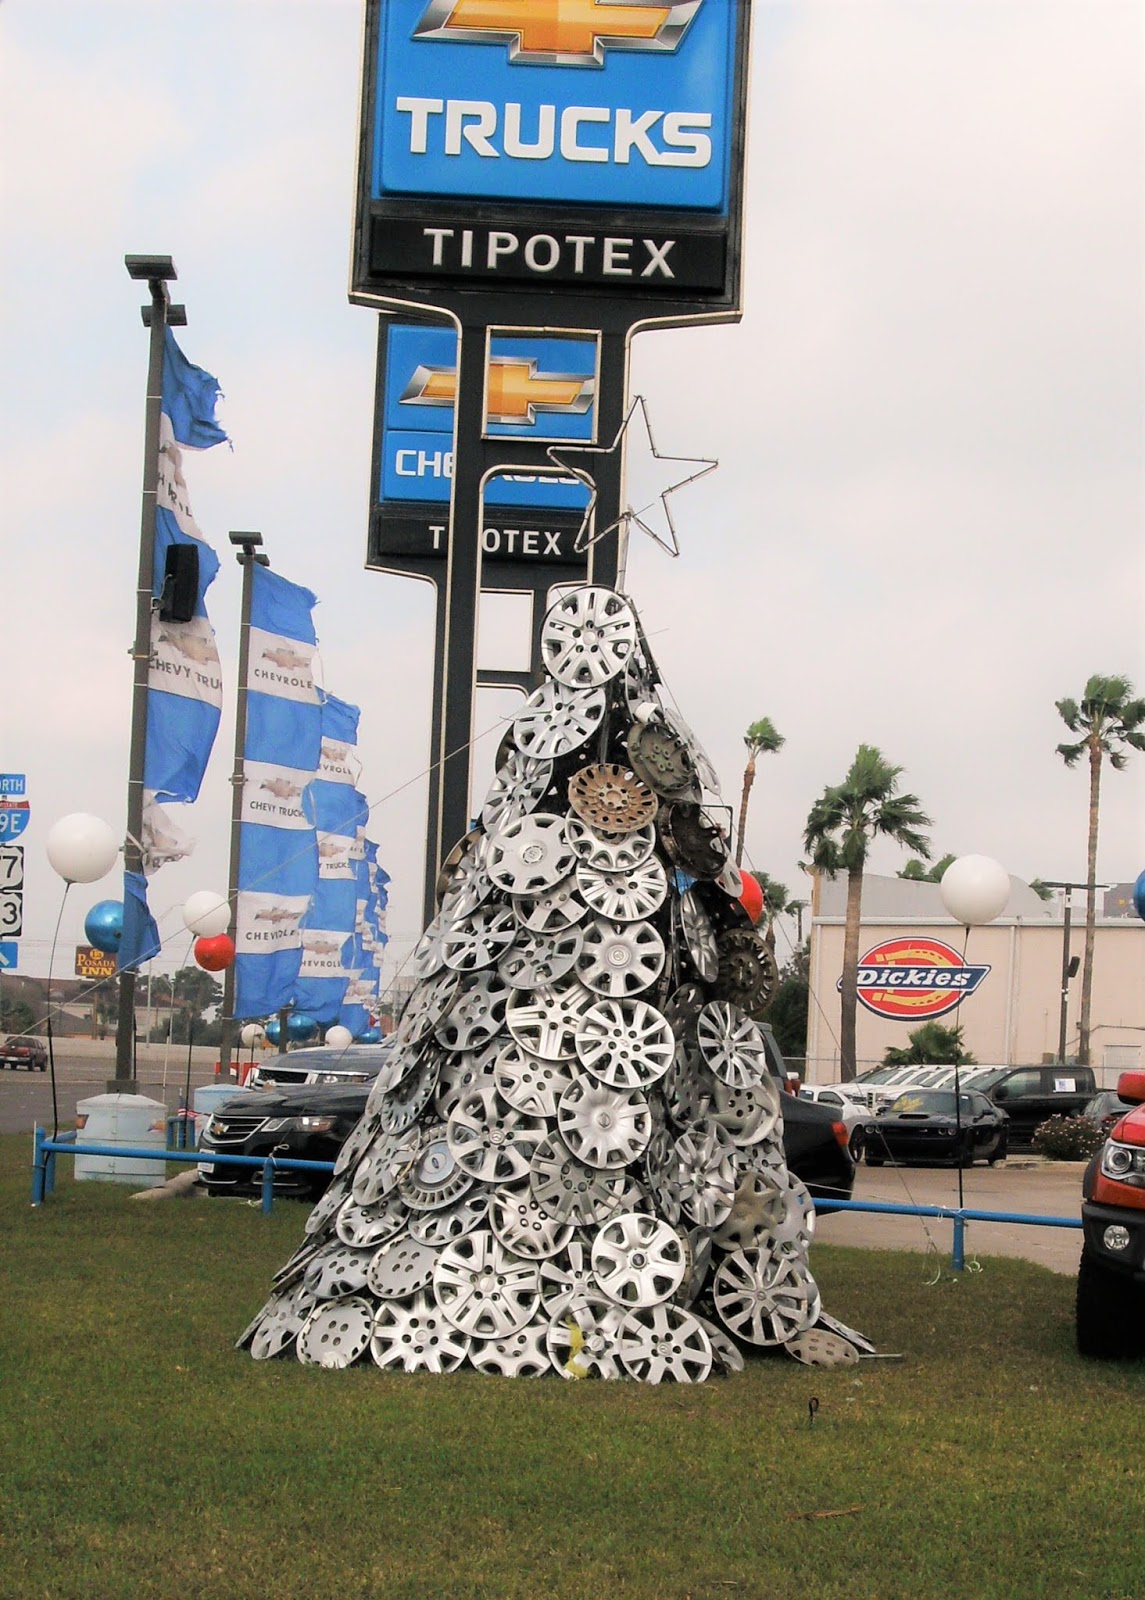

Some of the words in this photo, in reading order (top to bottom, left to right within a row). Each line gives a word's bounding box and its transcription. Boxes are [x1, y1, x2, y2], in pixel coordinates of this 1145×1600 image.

[396, 97, 712, 168] TRUCKS
[423, 228, 676, 279] TIPOTEX
[0, 779, 23, 791] RTH
[249, 800, 276, 813] CHEVY
[77, 953, 115, 967] POSADA
[81, 967, 113, 976] INN
[857, 969, 972, 986] Dickies
